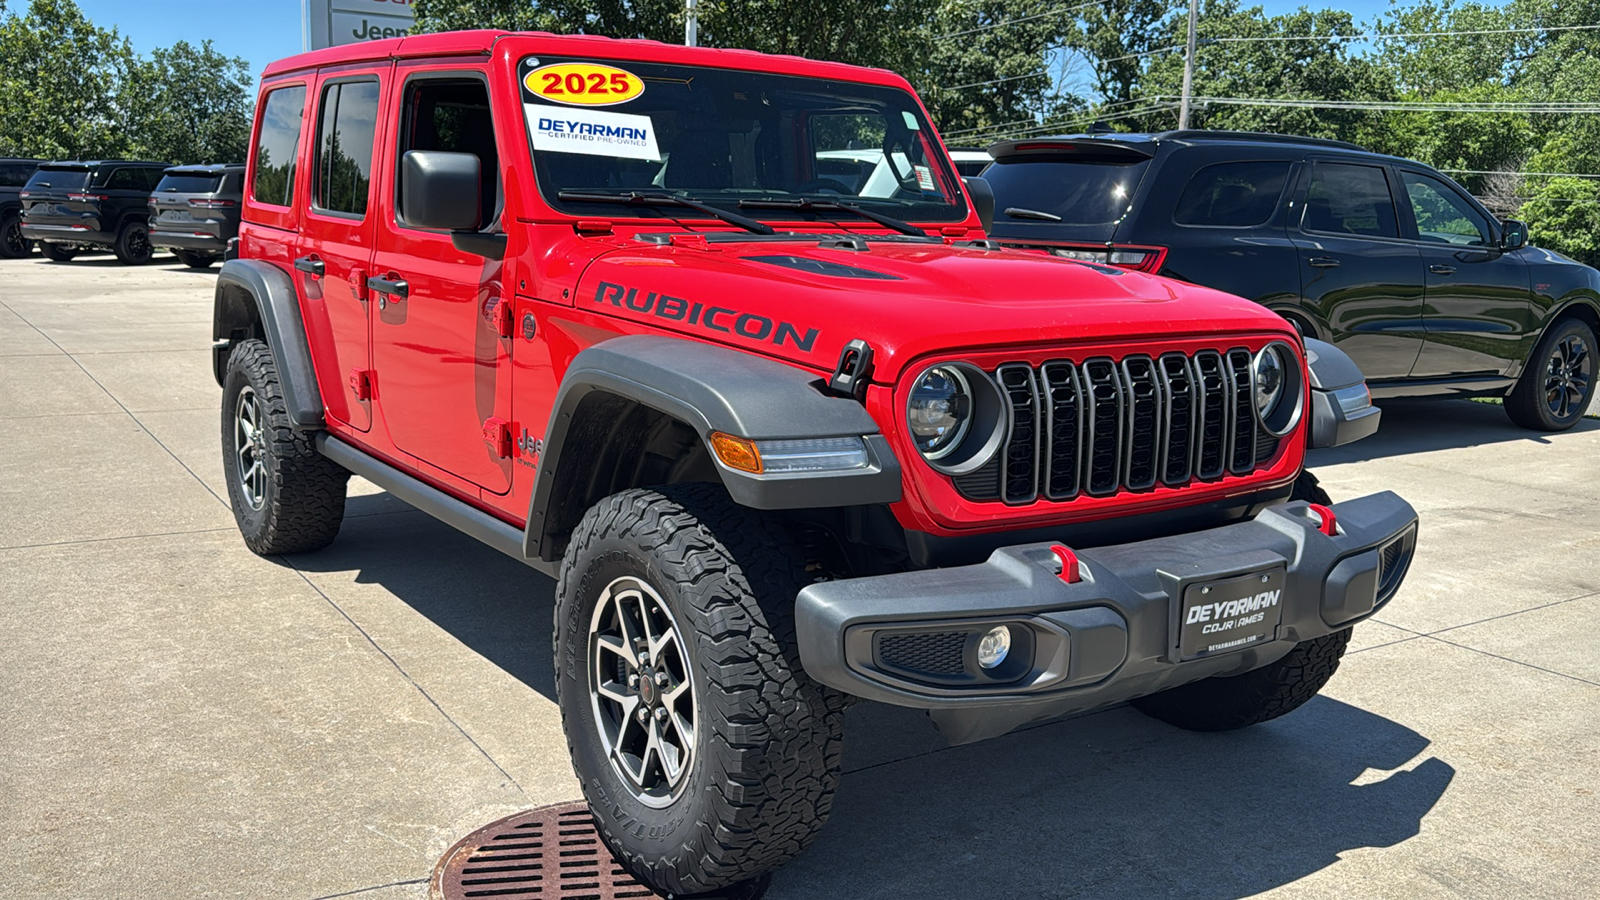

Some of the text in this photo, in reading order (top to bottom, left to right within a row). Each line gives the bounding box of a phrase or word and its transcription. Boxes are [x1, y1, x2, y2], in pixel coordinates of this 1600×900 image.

[542, 73, 630, 95] 2025
[538, 118, 647, 140] DEYARMAN
[547, 131, 647, 147] CERTIFIED PRE-OWNED
[594, 281, 822, 352] RUBICON
[517, 427, 544, 455] Jee
[1186, 589, 1281, 625] DEYARMAN
[1237, 612, 1265, 628] AMES
